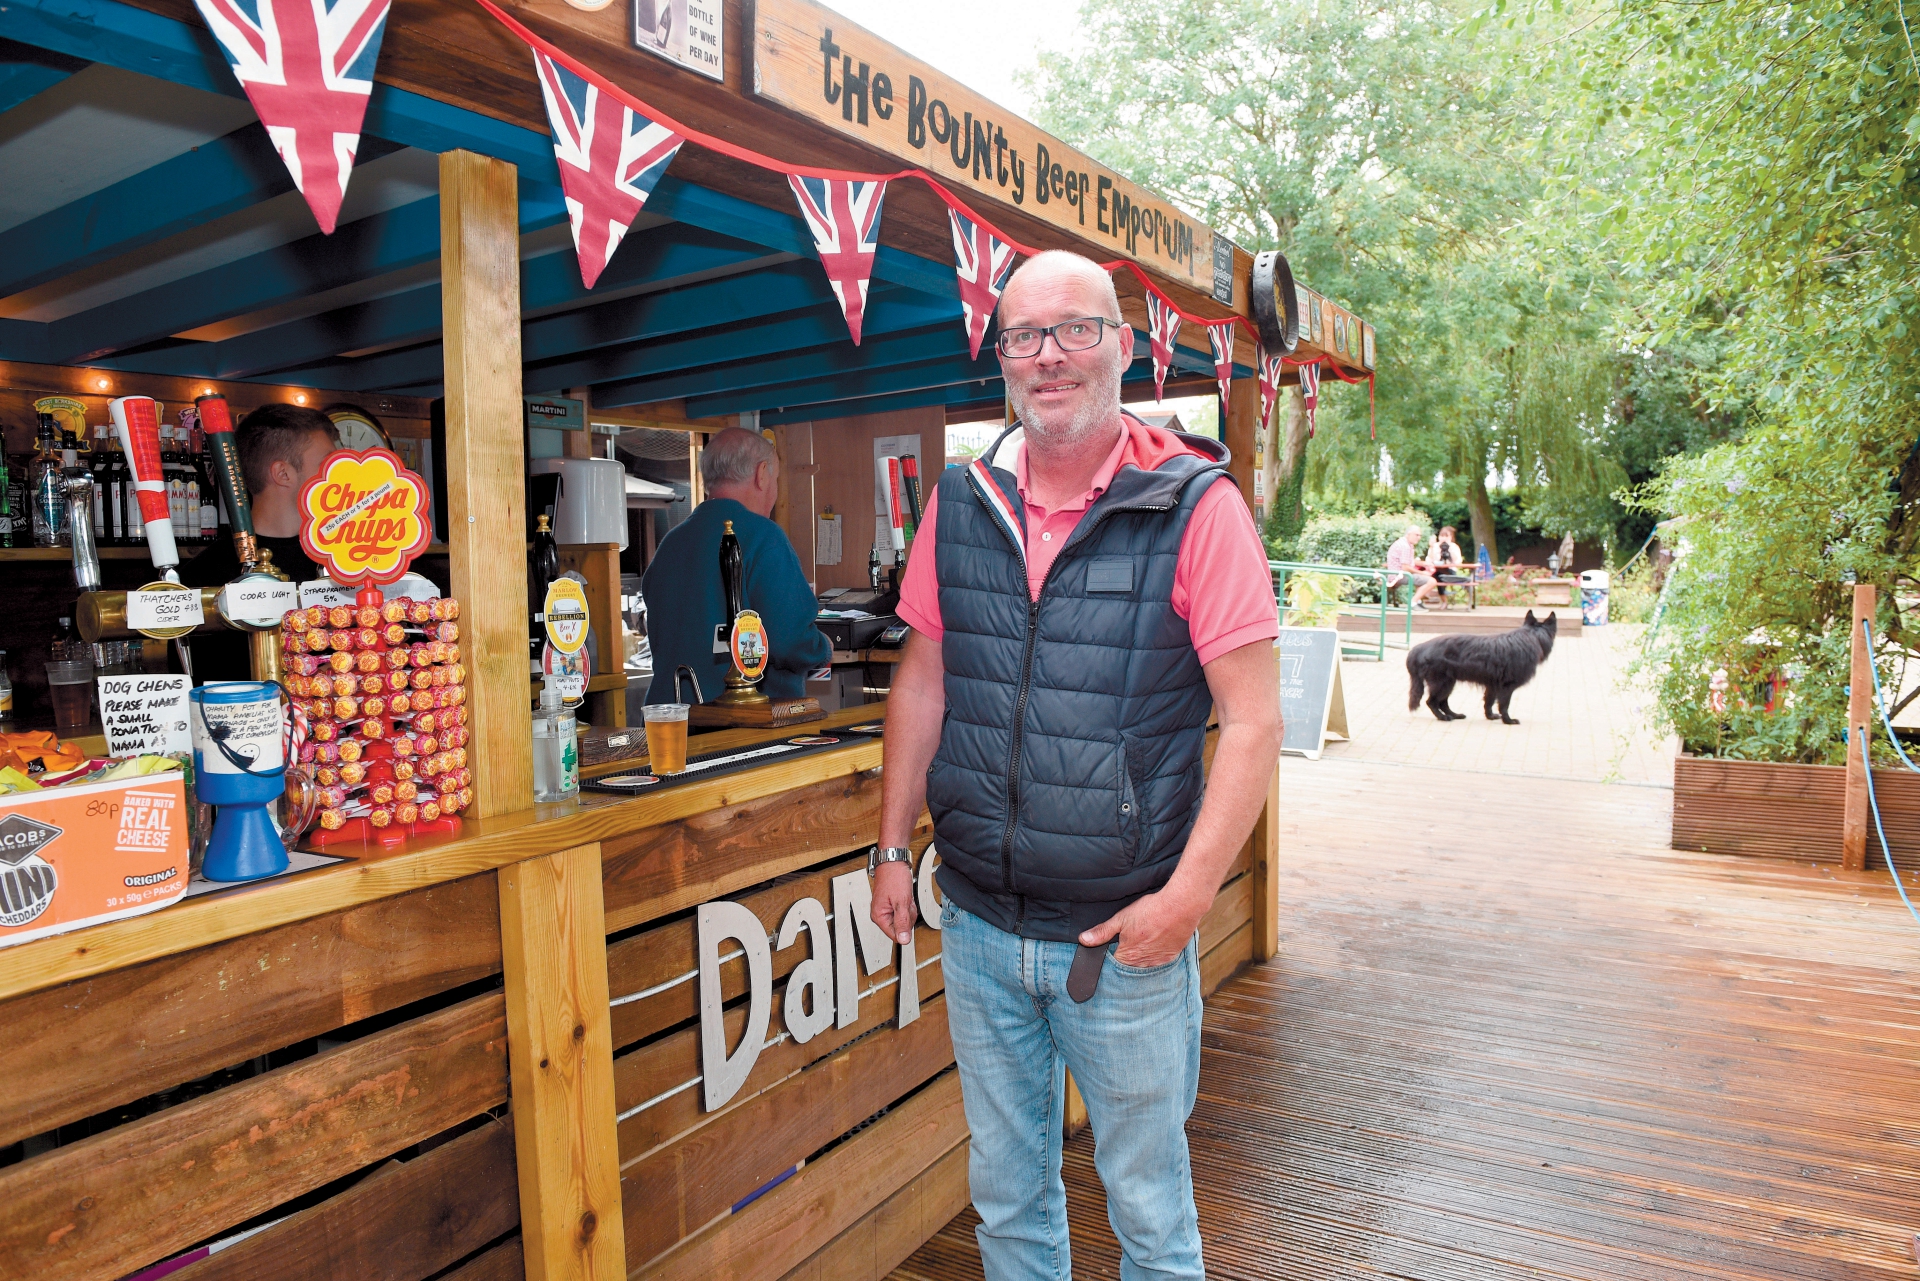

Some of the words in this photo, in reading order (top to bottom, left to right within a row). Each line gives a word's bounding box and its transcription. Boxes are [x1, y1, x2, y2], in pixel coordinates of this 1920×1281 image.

[689, 5, 713, 25] BOTTLE
[689, 25, 698, 38] OF
[700, 30, 717, 46] WINE
[689, 45, 702, 60] PER
[704, 53, 719, 66] DAY
[1036, 142, 1089, 225] Beer
[532, 405, 566, 415] MARTINI
[222, 442, 232, 462] BEER
[325, 523, 336, 532] 25p
[335, 511, 351, 525] EACH
[373, 483, 390, 498] pound
[140, 593, 193, 603] THATCHERS
[240, 592, 267, 601] COORS
[272, 591, 291, 600] LIGHT
[156, 604, 181, 614] GOLD
[549, 613, 585, 621] REBELLION
[157, 615, 180, 623] CIDER
[104, 681, 131, 695] DOG
[137, 679, 184, 693] CHEWS
[1280, 687, 1304, 699] ACK
[105, 699, 143, 713] PLEASE
[147, 696, 180, 709] MAKE
[106, 715, 114, 726] A
[117, 713, 153, 723] SMALL
[173, 720, 188, 731] TO
[111, 739, 145, 753] MAMA
[86, 800, 119, 819] 80p
[123, 796, 151, 807] BAKED
[153, 798, 175, 808] WITH
[120, 807, 171, 831] REAL
[117, 829, 170, 847] CHEESE
[124, 867, 177, 887] ORIGINAL
[106, 898, 118, 907] 30
[126, 893, 142, 903] 50g
[153, 881, 183, 896] PACKS
[0, 897, 47, 925] CHEDDARS
